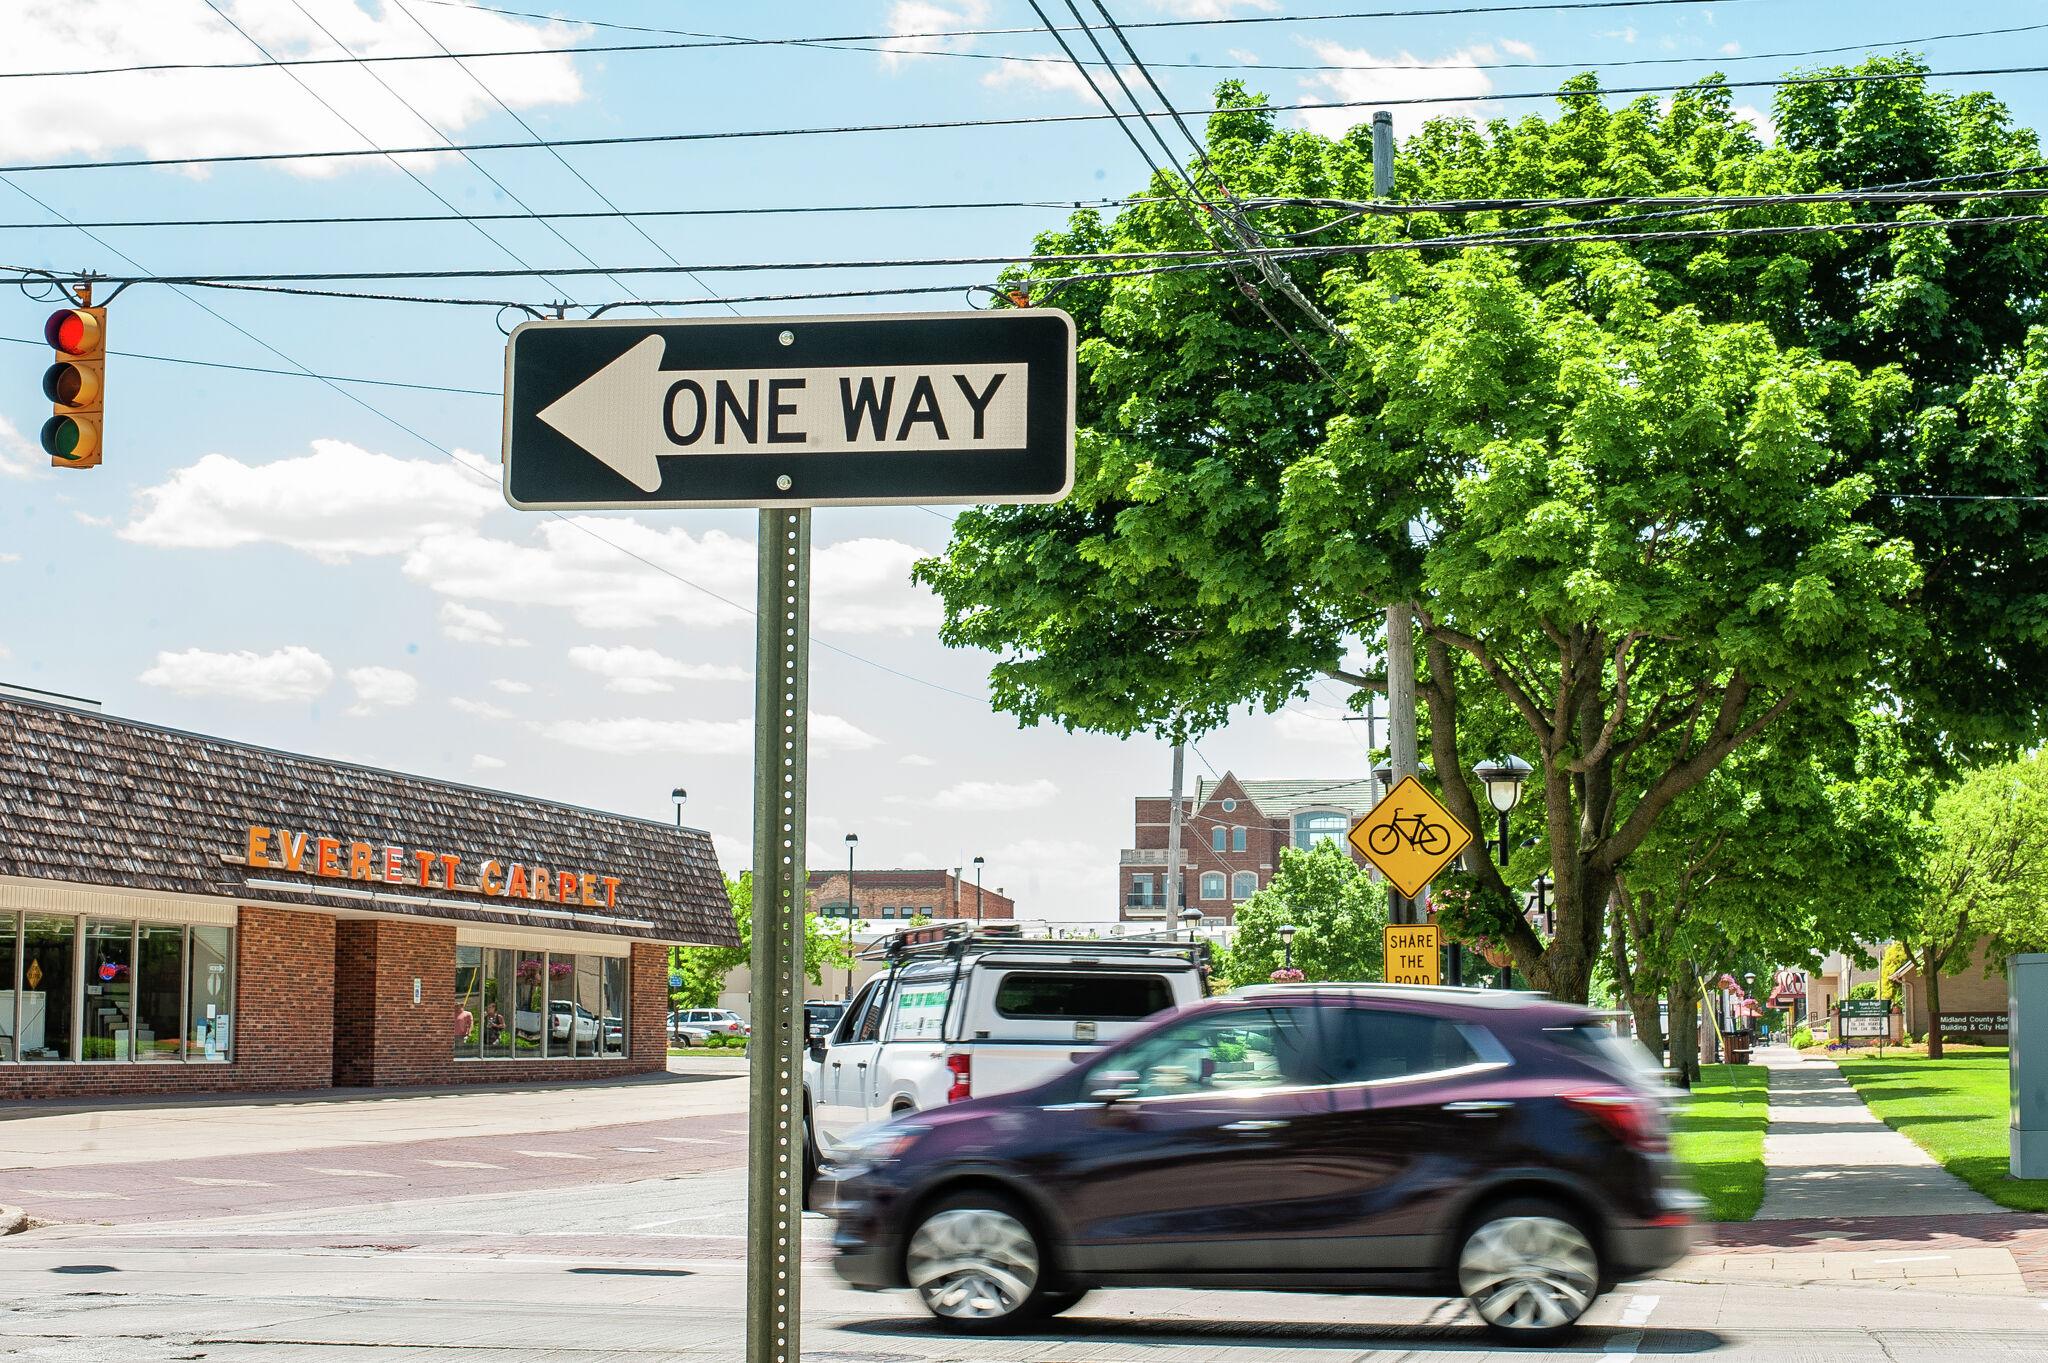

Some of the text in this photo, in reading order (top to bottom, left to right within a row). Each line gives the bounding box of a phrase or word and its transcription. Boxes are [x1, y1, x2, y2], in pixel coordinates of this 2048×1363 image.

[662, 373, 1007, 446] ONE WAY
[245, 825, 621, 908] EVERETT CARPET
[1390, 934, 1433, 948] SHARE
[1399, 955, 1424, 968] THE
[1394, 974, 1430, 985] ROAD
